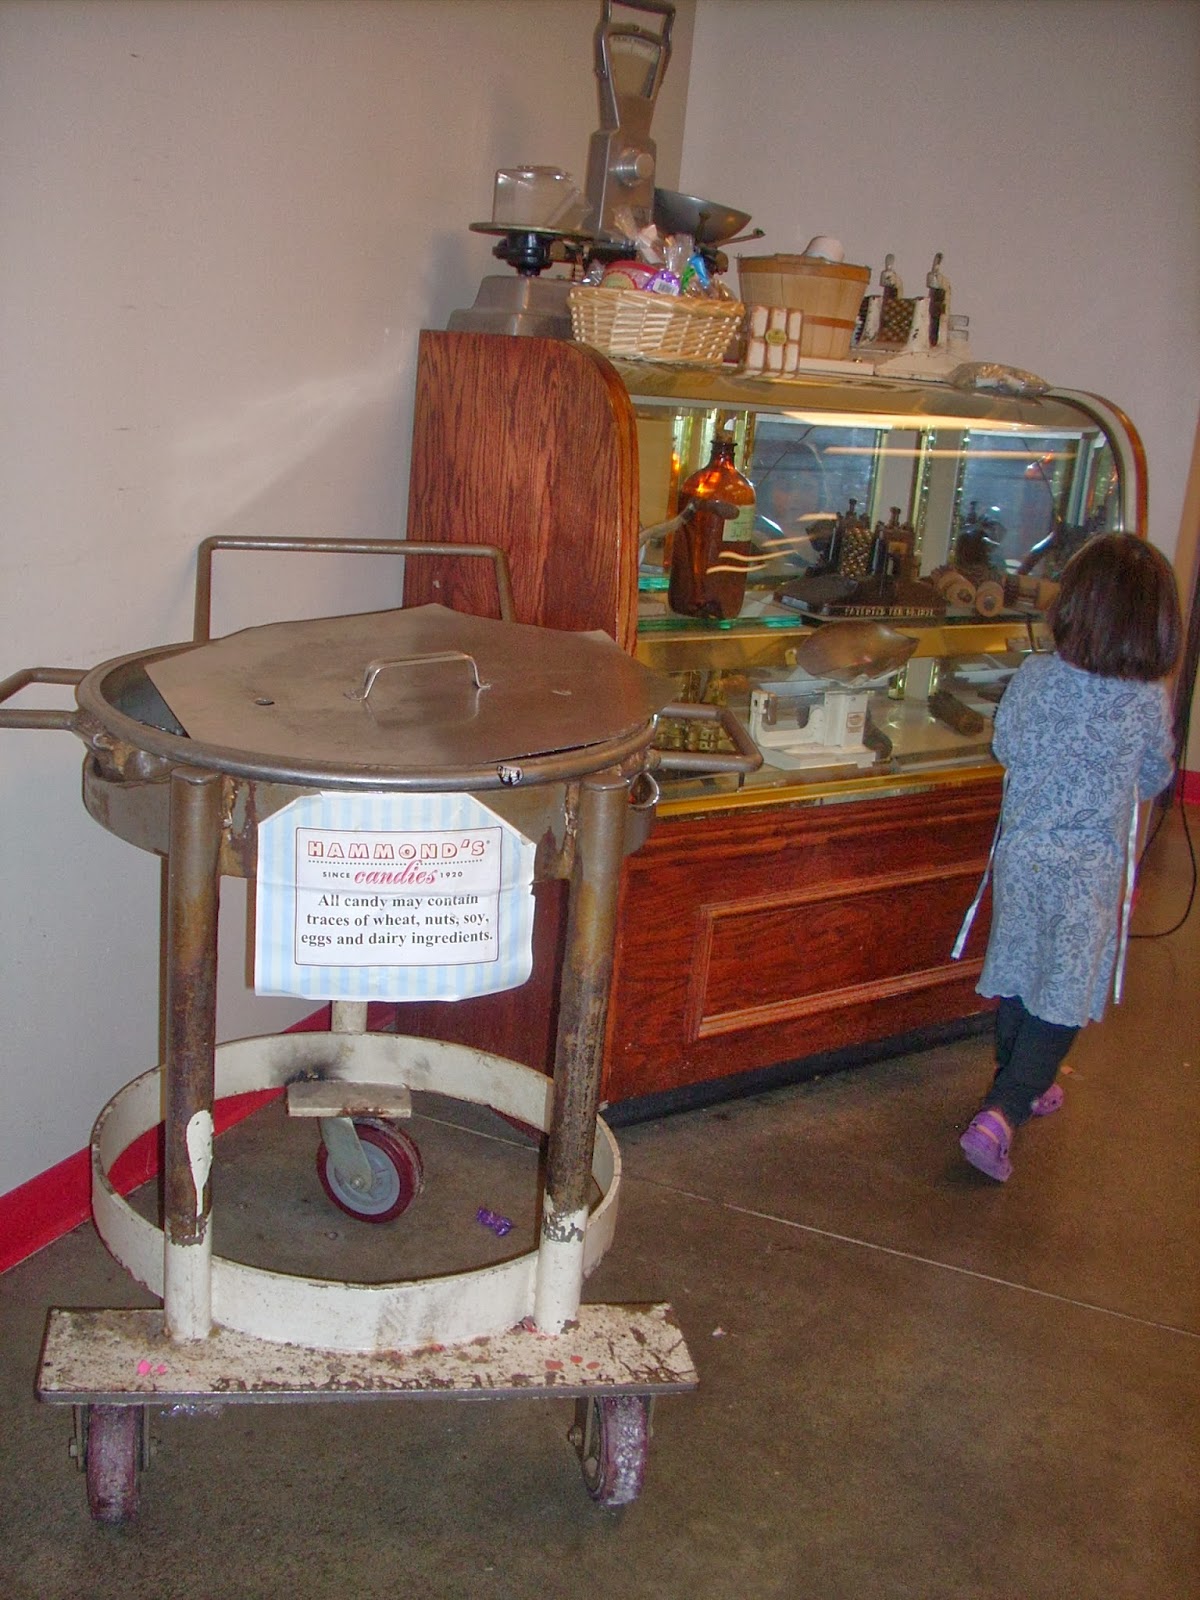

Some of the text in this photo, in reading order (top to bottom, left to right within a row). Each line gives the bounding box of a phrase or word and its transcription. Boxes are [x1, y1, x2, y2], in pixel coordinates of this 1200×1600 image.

[308, 839, 486, 859] HAMMOND'S
[322, 871, 351, 879] SINCE
[354, 860, 438, 885] candies
[318, 894, 479, 910] All candy may contain
[307, 913, 490, 927] traces of wheat, nuts, soy,
[301, 930, 493, 947] eggs and dairy ingredients.
